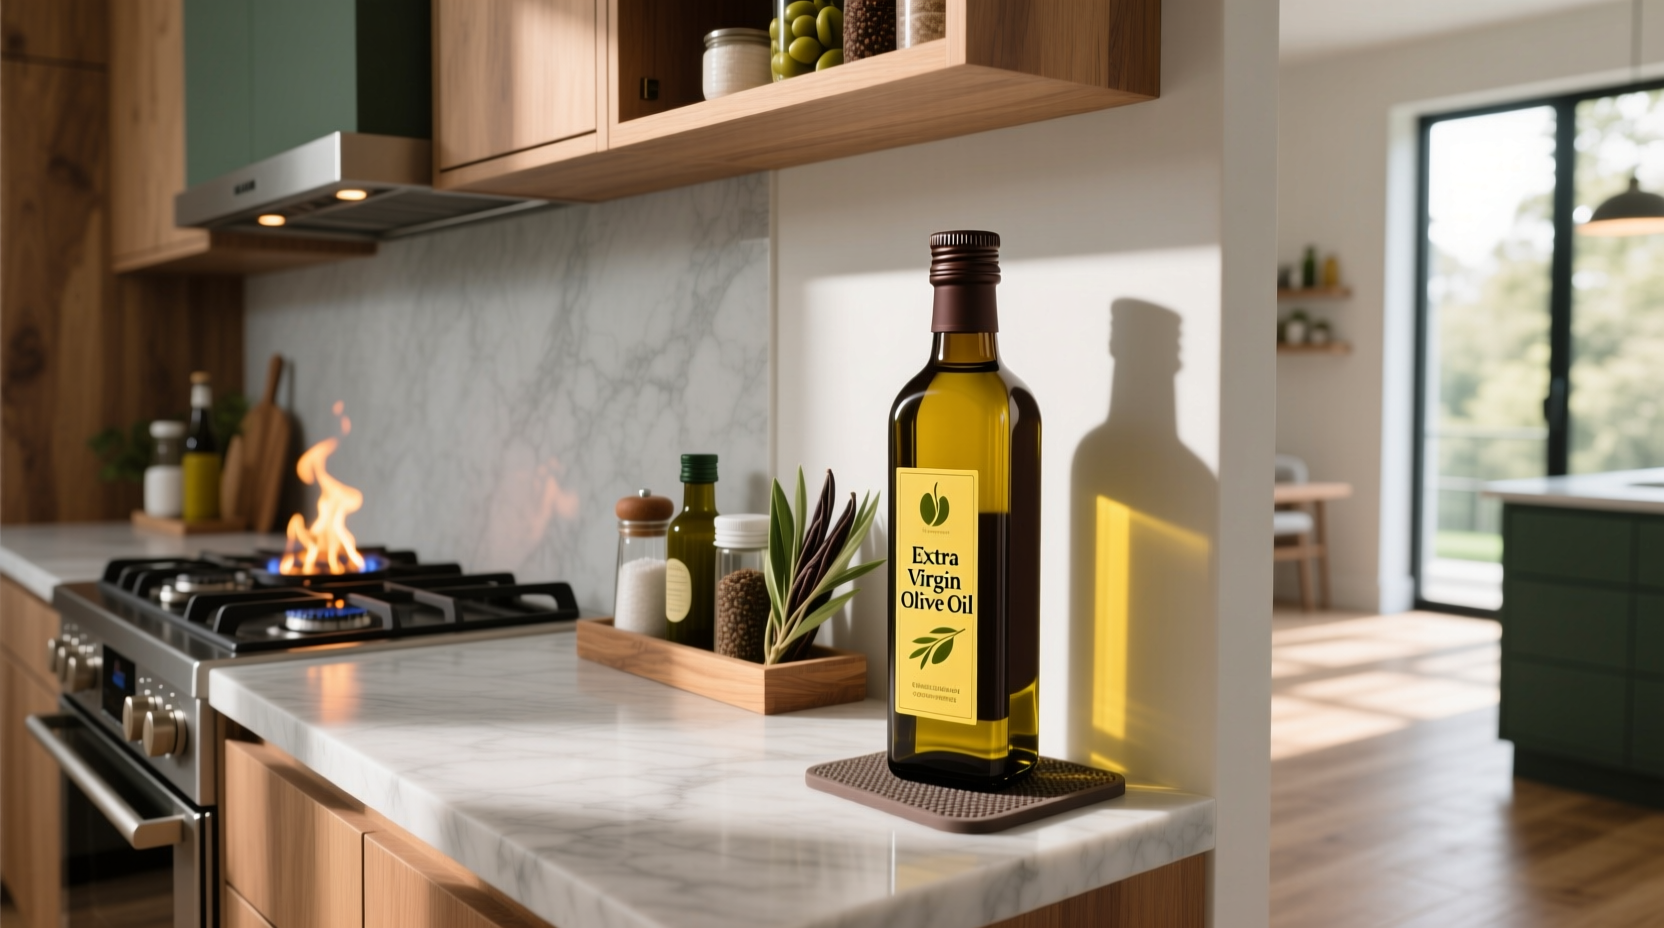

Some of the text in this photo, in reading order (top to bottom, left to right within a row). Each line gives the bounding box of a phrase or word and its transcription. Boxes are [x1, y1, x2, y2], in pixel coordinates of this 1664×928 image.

[912, 546, 959, 566] Extra
[907, 568, 962, 594] Virgin
[901, 590, 973, 614] Olive Oil
